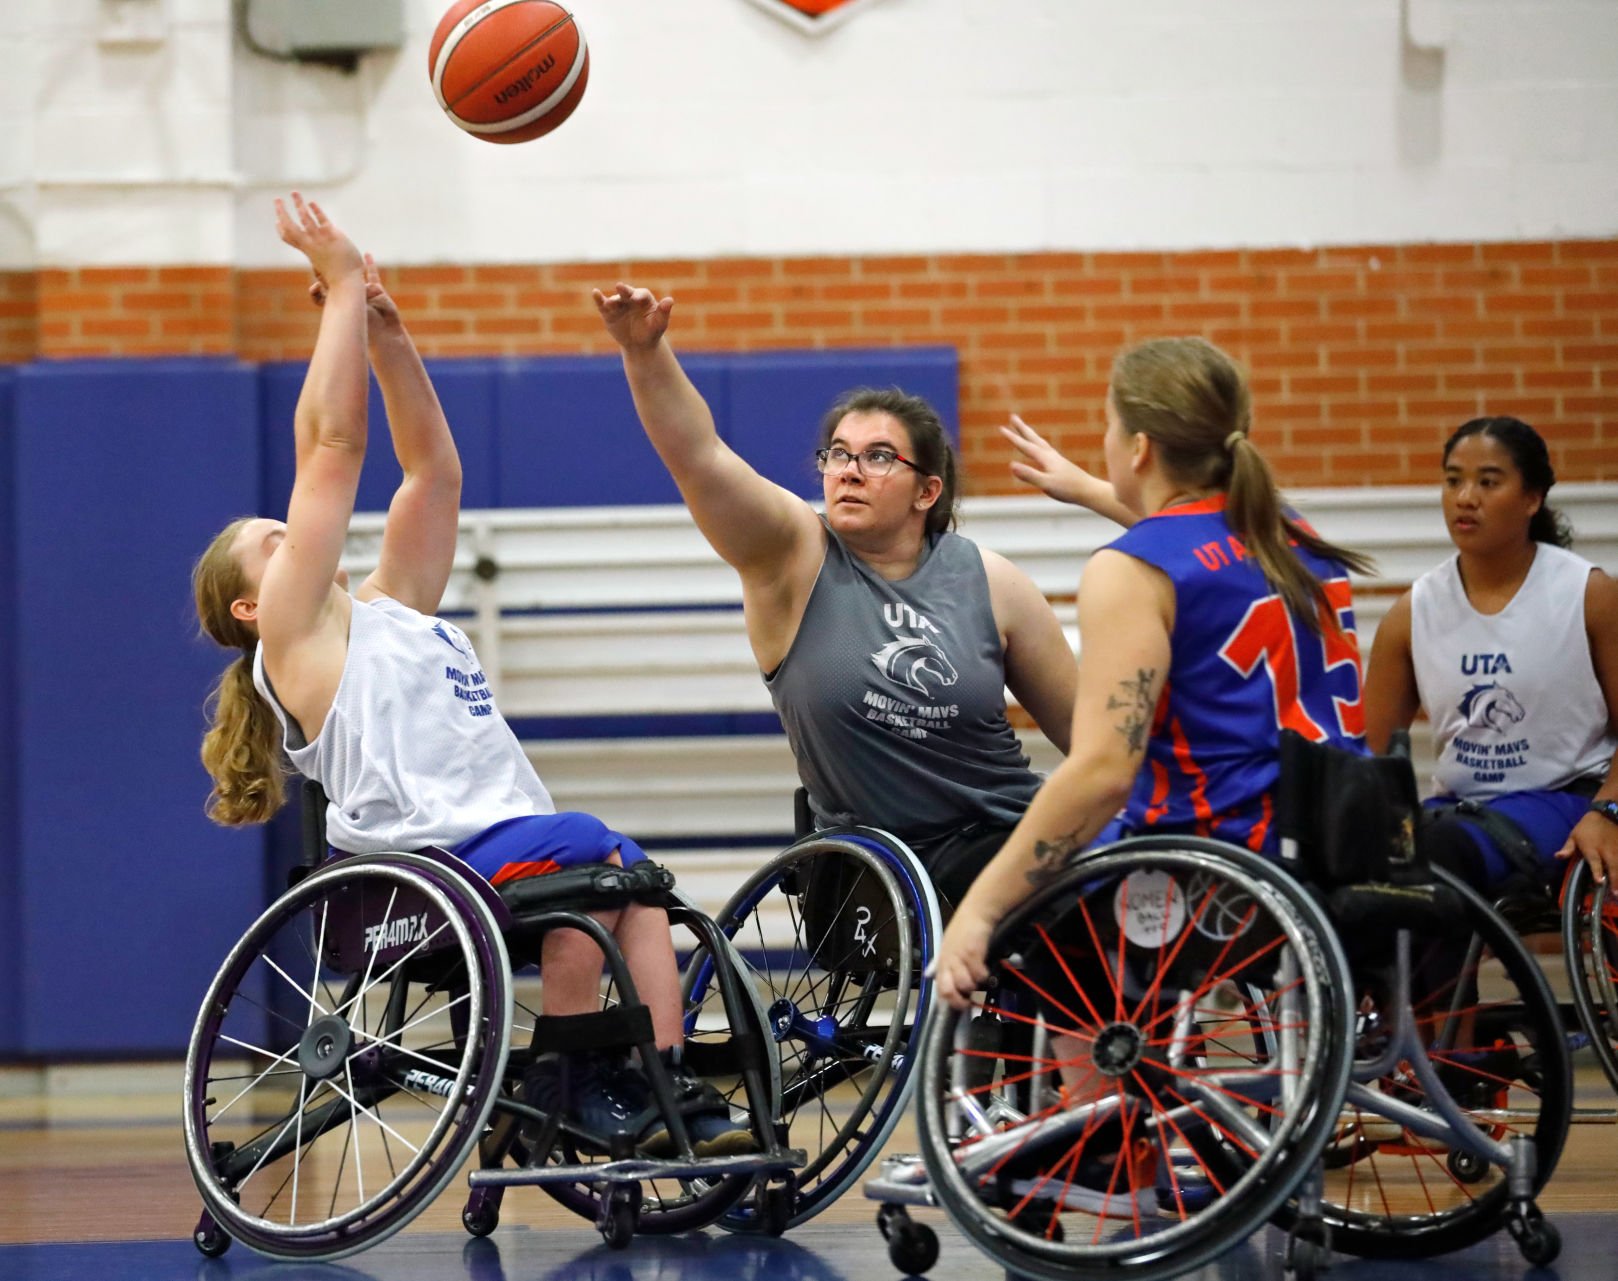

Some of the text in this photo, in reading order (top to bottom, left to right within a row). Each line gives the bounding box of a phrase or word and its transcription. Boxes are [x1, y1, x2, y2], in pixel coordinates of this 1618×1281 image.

[493, 53, 556, 105] molten
[1193, 541, 1231, 571] UT
[884, 602, 941, 634] UTA
[1217, 576, 1367, 744] 15
[1461, 653, 1512, 676] UTA
[468, 704, 493, 717] CAMP
[866, 708, 952, 729] BASKETBALL
[917, 704, 960, 719] MAVS
[1453, 736, 1530, 756] MOVIN' MAVS
[1456, 753, 1527, 770] BASKETBALL
[1473, 771, 1506, 783] CAMP
